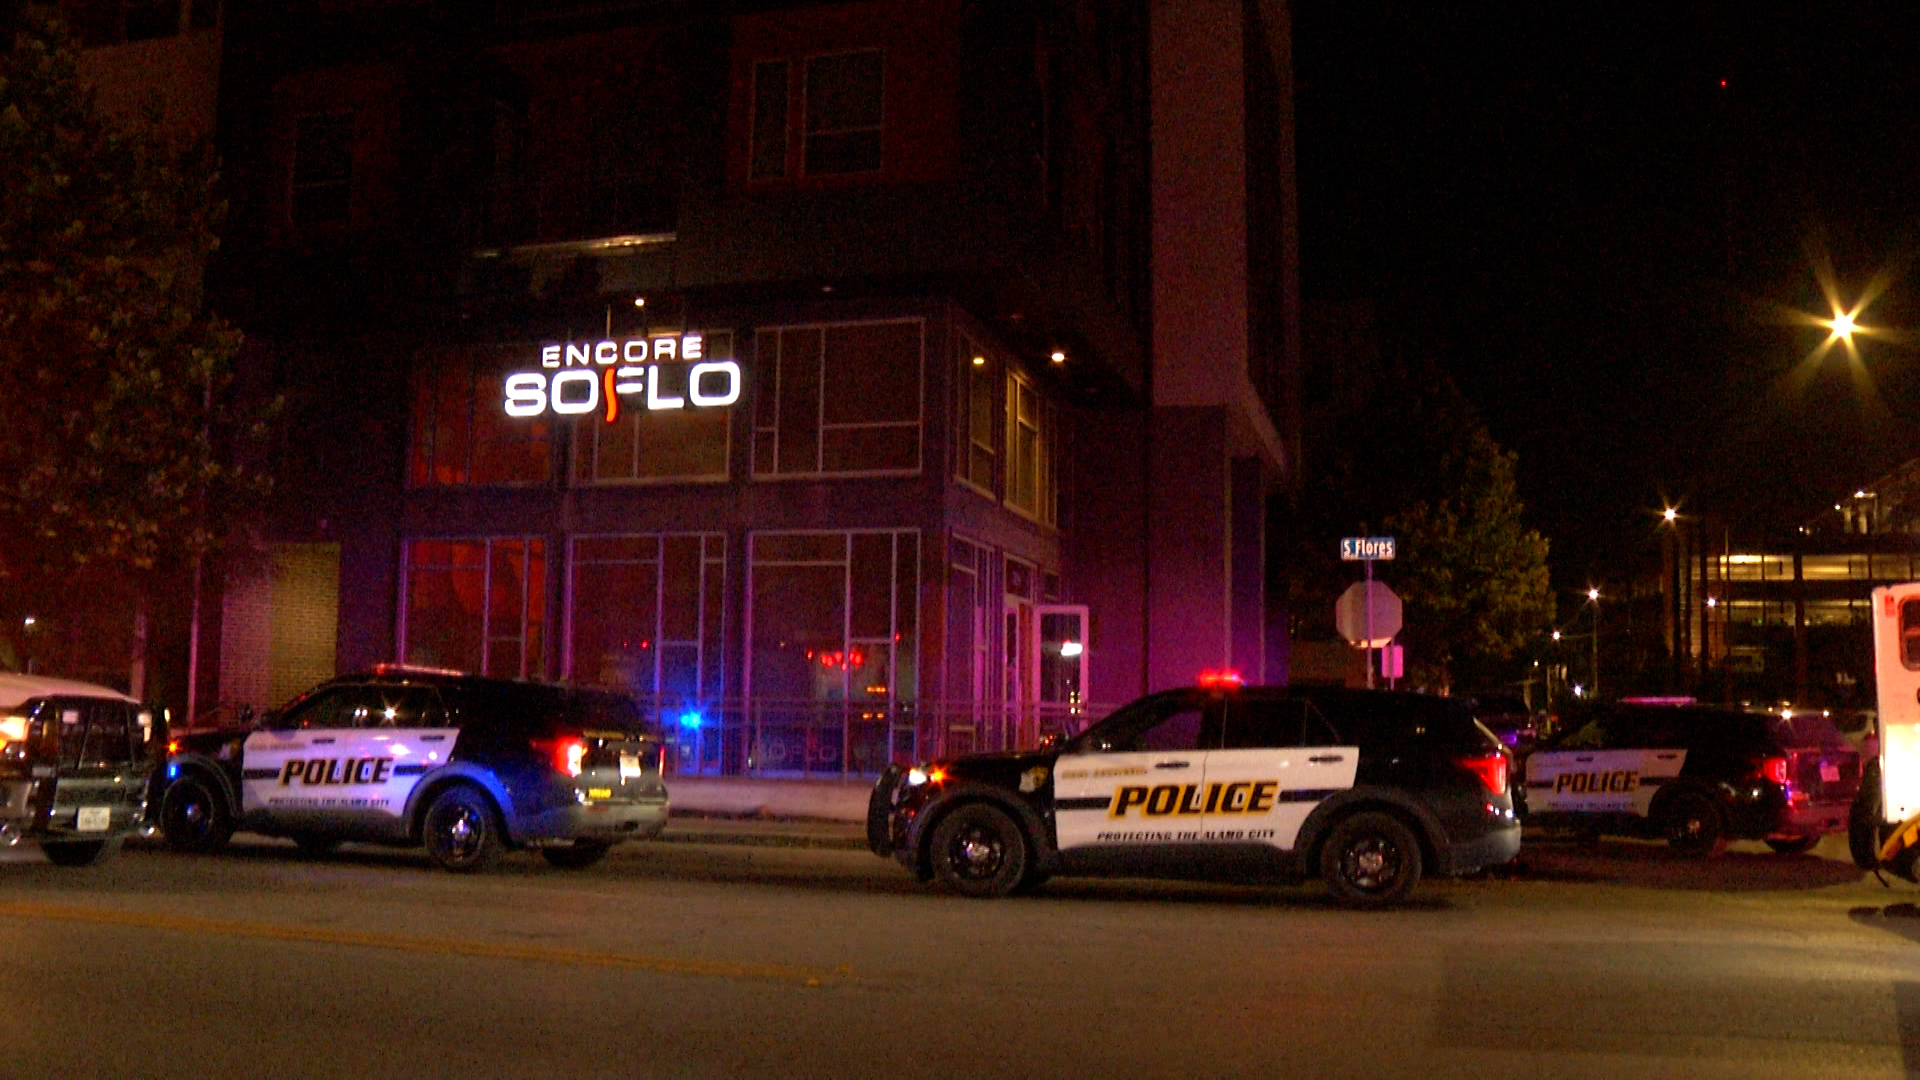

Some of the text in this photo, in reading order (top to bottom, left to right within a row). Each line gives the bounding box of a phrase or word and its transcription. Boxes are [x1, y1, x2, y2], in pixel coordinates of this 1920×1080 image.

[542, 335, 702, 368] ENCORE
[505, 361, 741, 423] SOFLO
[1355, 538, 1393, 558] Flores
[281, 757, 393, 786] POLICE
[1554, 771, 1639, 794] POLICE
[1109, 781, 1279, 818] POLICE
[1096, 829, 1276, 841] PROTECTING THE ALAMO CITY
